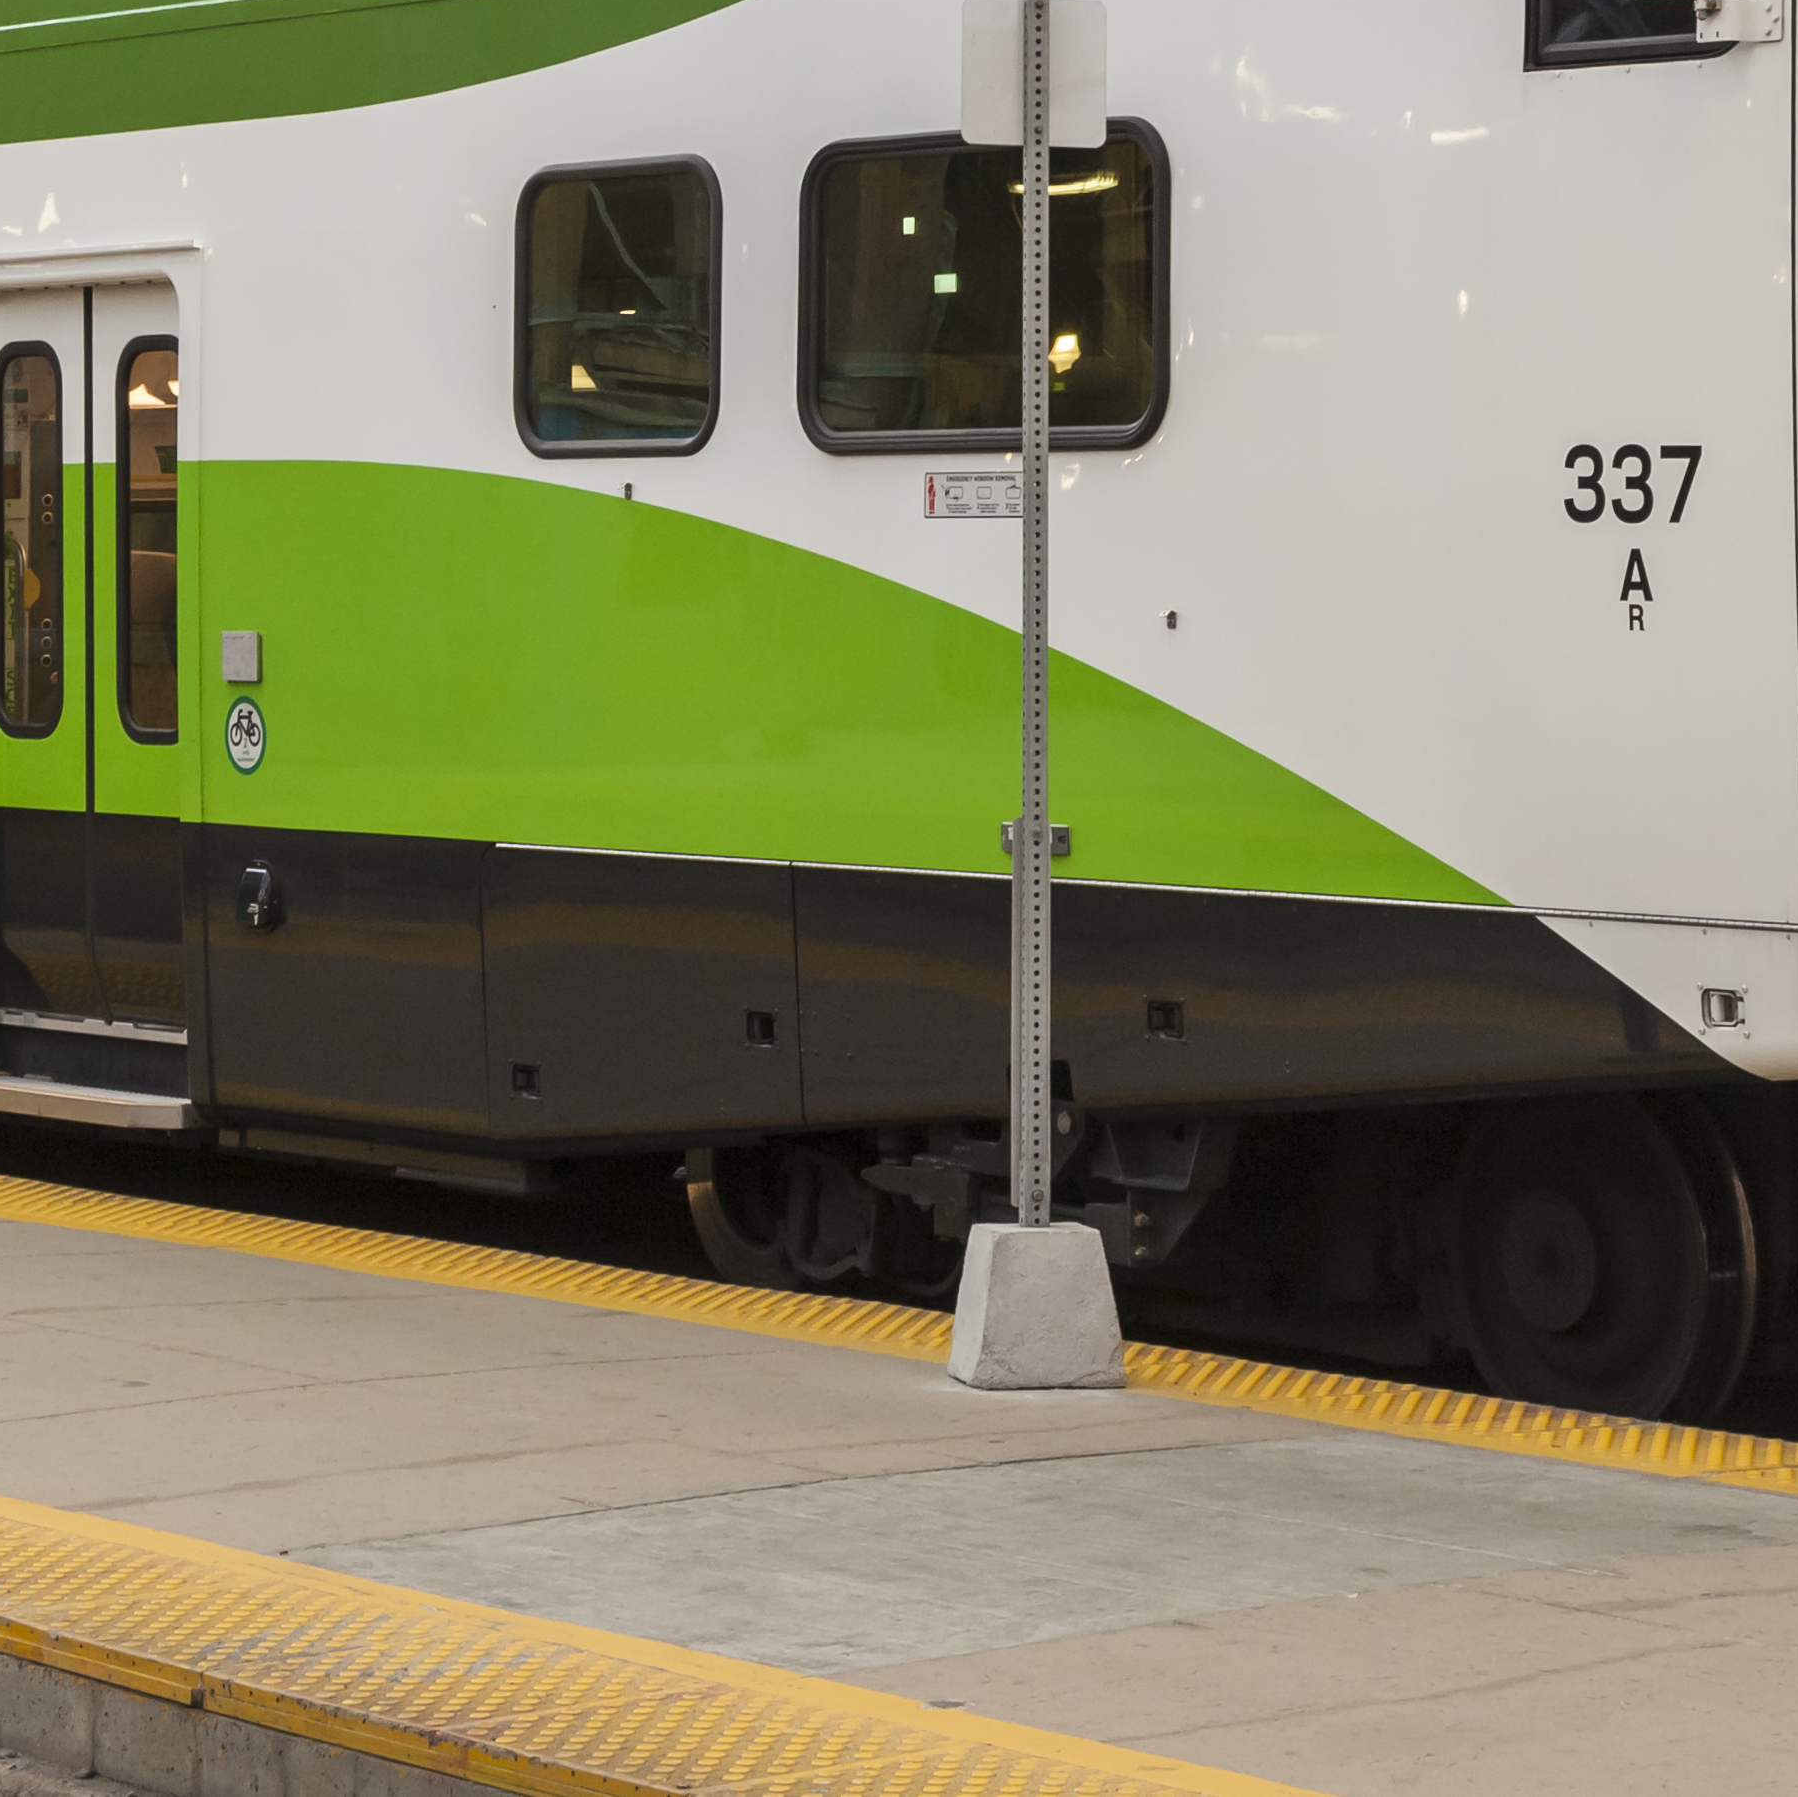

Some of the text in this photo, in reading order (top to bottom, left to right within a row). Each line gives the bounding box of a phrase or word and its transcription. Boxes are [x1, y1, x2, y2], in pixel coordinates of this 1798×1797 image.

[946, 475, 973, 483] EMERGENCY
[1563, 443, 1703, 524] 337
[1619, 548, 1654, 602] A
[1628, 603, 1645, 631] R
